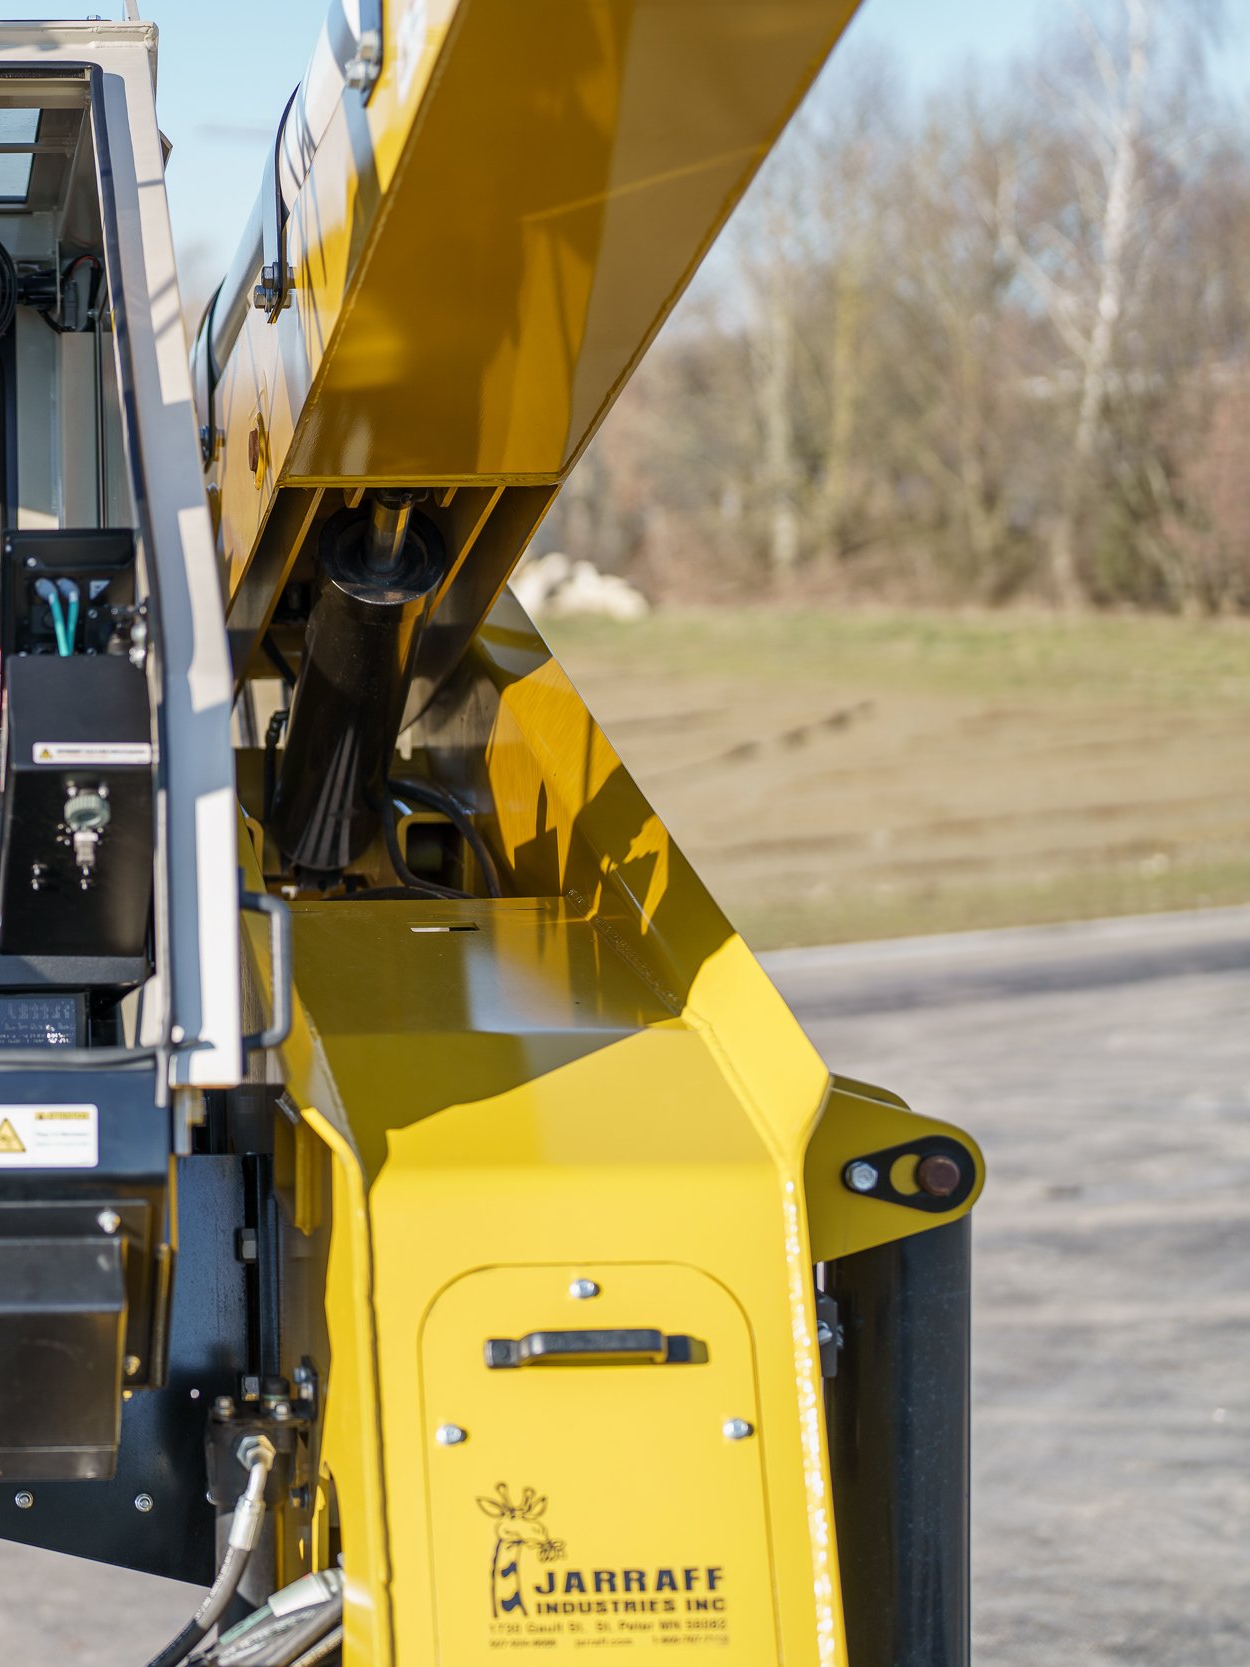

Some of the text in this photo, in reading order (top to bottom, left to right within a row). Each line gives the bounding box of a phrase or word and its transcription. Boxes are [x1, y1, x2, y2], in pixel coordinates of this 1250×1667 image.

[535, 1567, 724, 1595] JARRAFF
[536, 1597, 726, 1615] INDUSTRIES INC
